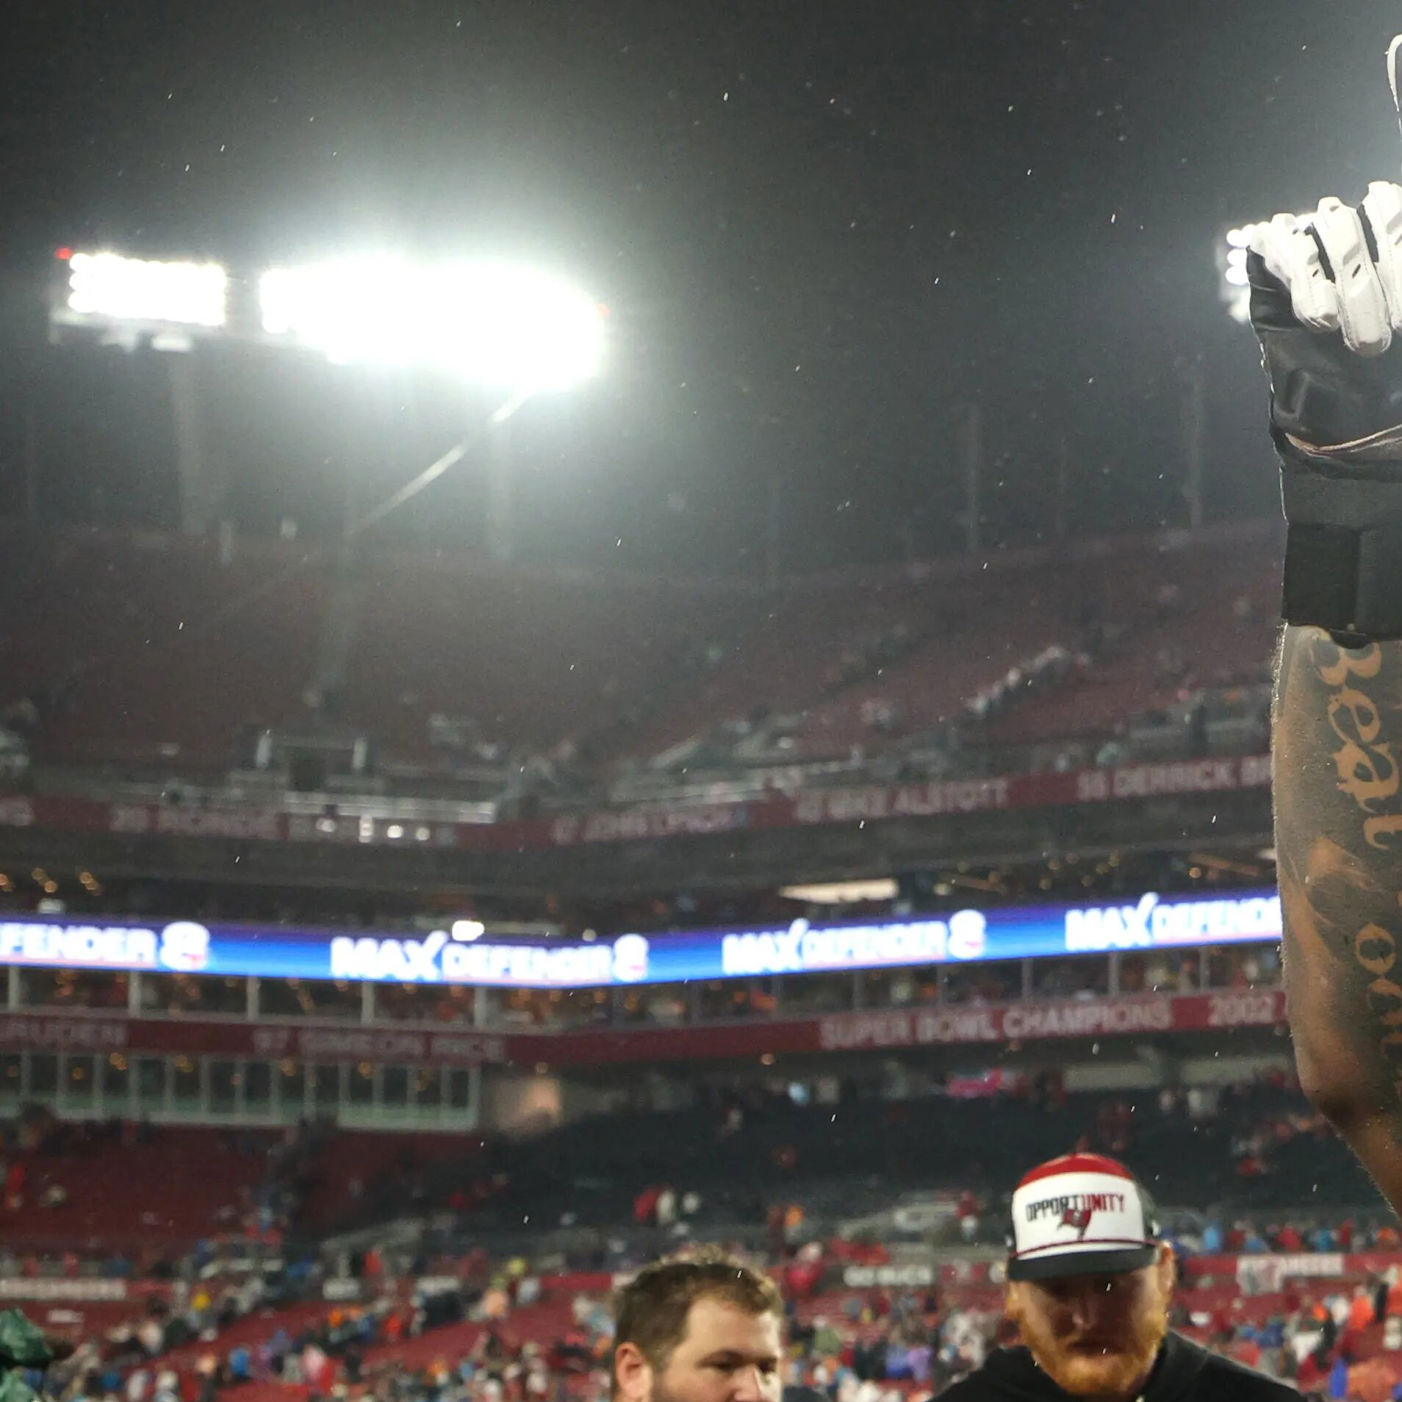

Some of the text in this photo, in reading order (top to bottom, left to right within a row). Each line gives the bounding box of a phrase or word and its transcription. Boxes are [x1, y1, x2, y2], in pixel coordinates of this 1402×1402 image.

[721, 917, 810, 976] MAX
[801, 920, 947, 967] DEFENDER
[1065, 892, 1283, 952] MAX DEFEND
[330, 930, 449, 982] MAX
[441, 943, 613, 981] DEFENDER
[1024, 1192, 1127, 1223] OPPORTUNITY
